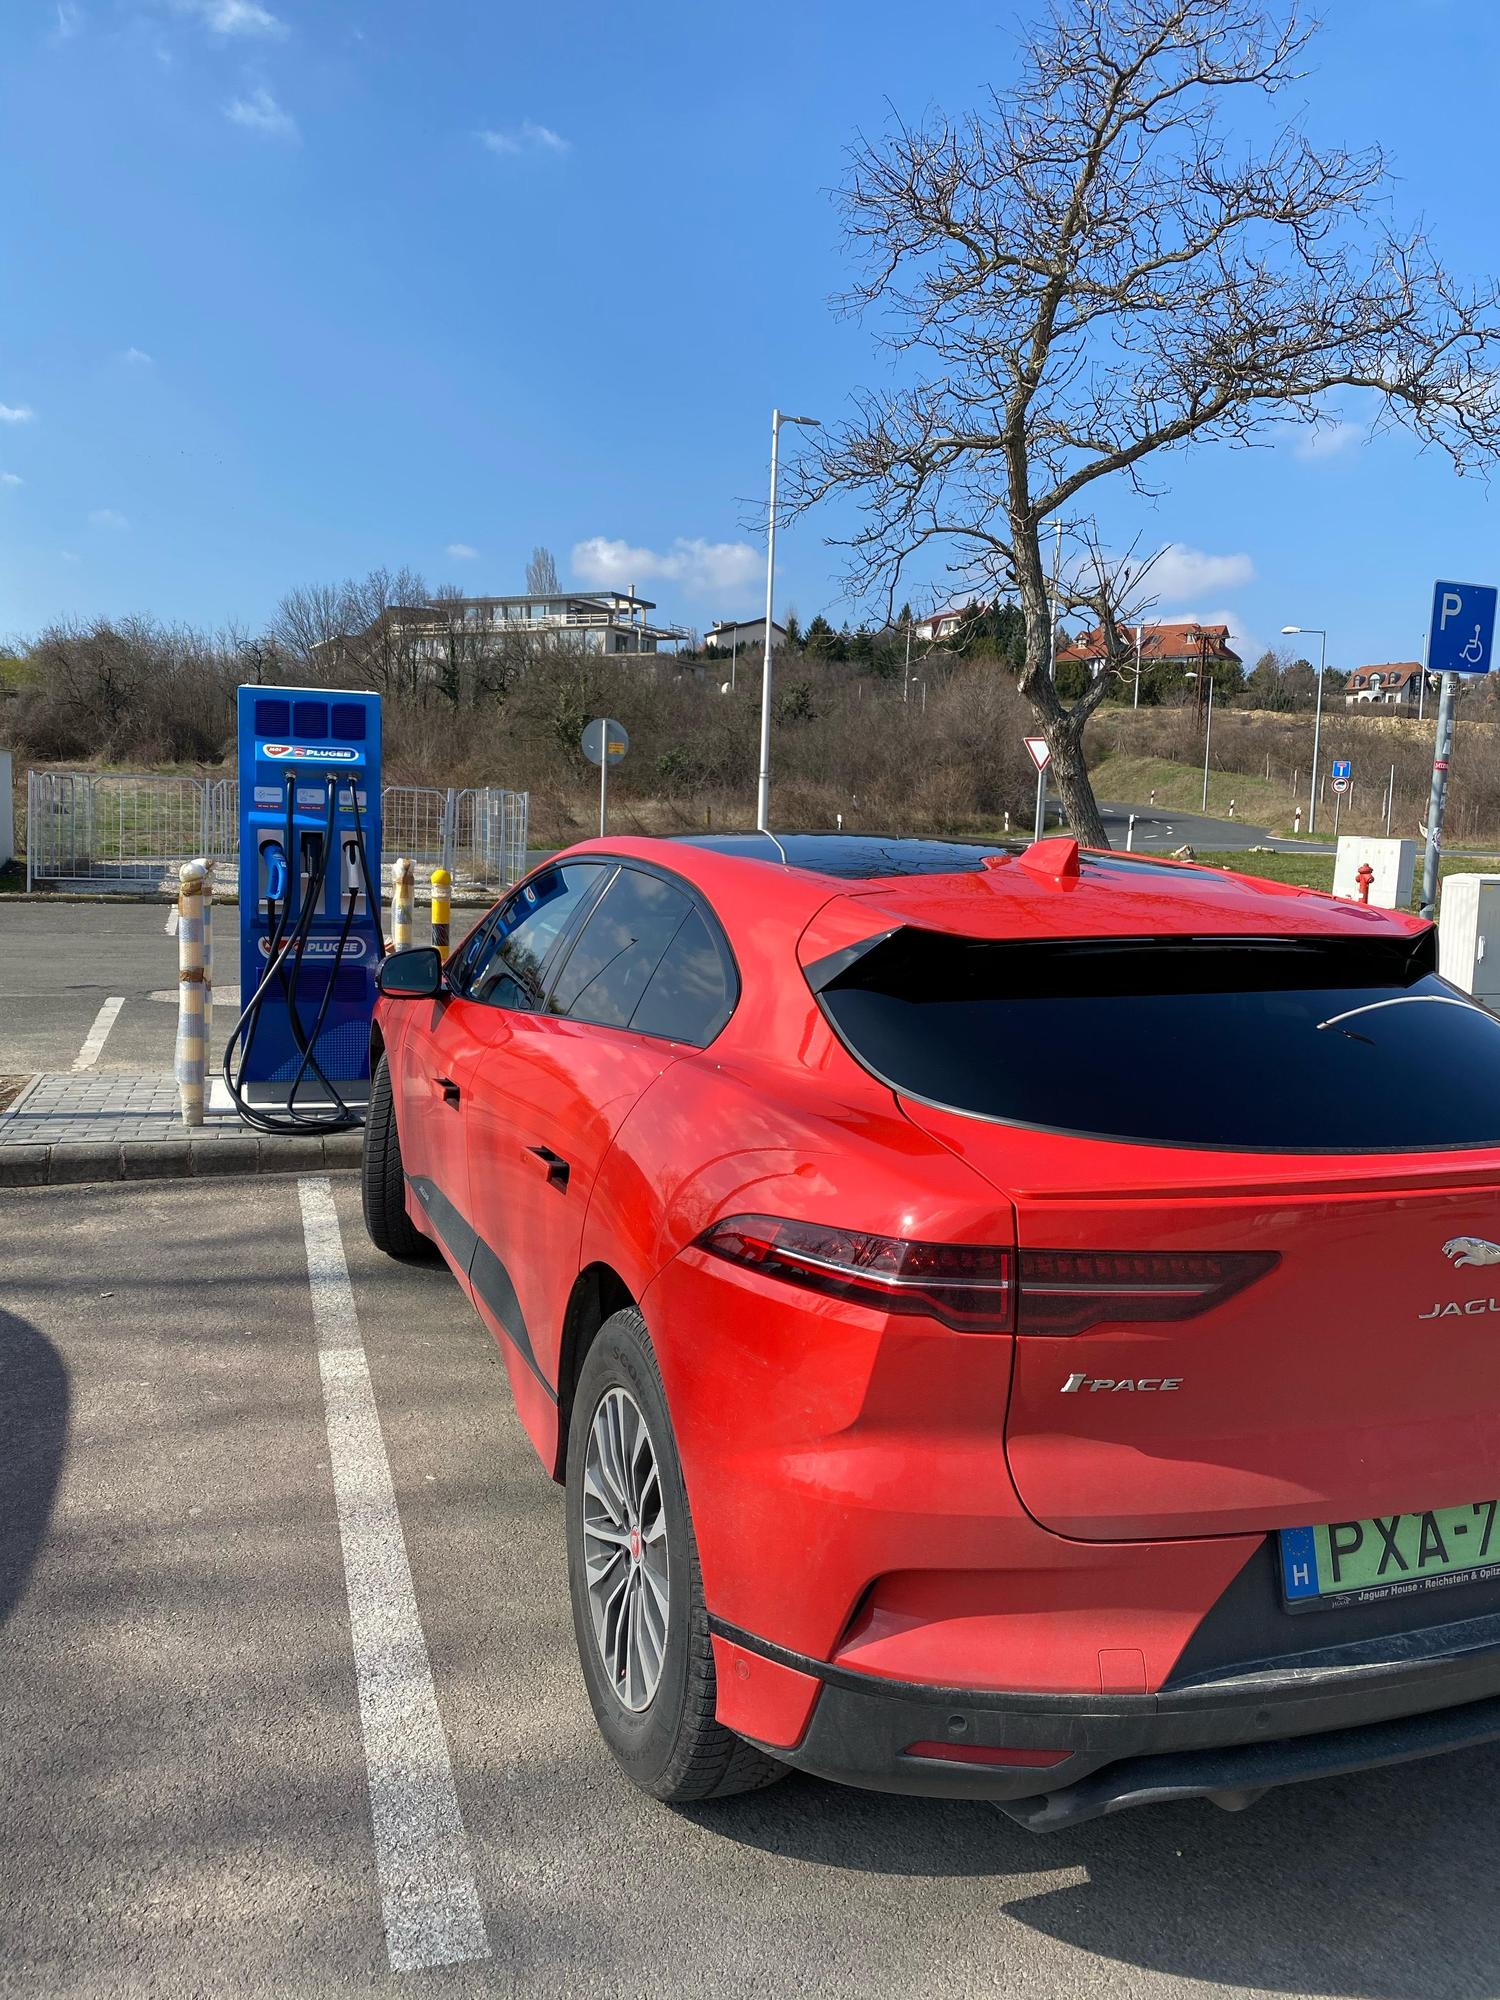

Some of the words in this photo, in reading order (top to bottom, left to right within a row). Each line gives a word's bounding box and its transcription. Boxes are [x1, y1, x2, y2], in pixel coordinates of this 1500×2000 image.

[1440, 592, 1462, 631] P
[306, 749, 351, 758] PLUGEE
[1060, 1373, 1184, 1392] I-PACE
[1328, 1500, 1497, 1583] PXA-7
[1292, 1563, 1309, 1586] H
[1358, 1588, 1389, 1601] Jaguar
[1391, 1583, 1418, 1595] House
[1425, 1572, 1469, 1589] Reichstein
[1471, 1571, 1478, 1580] &
